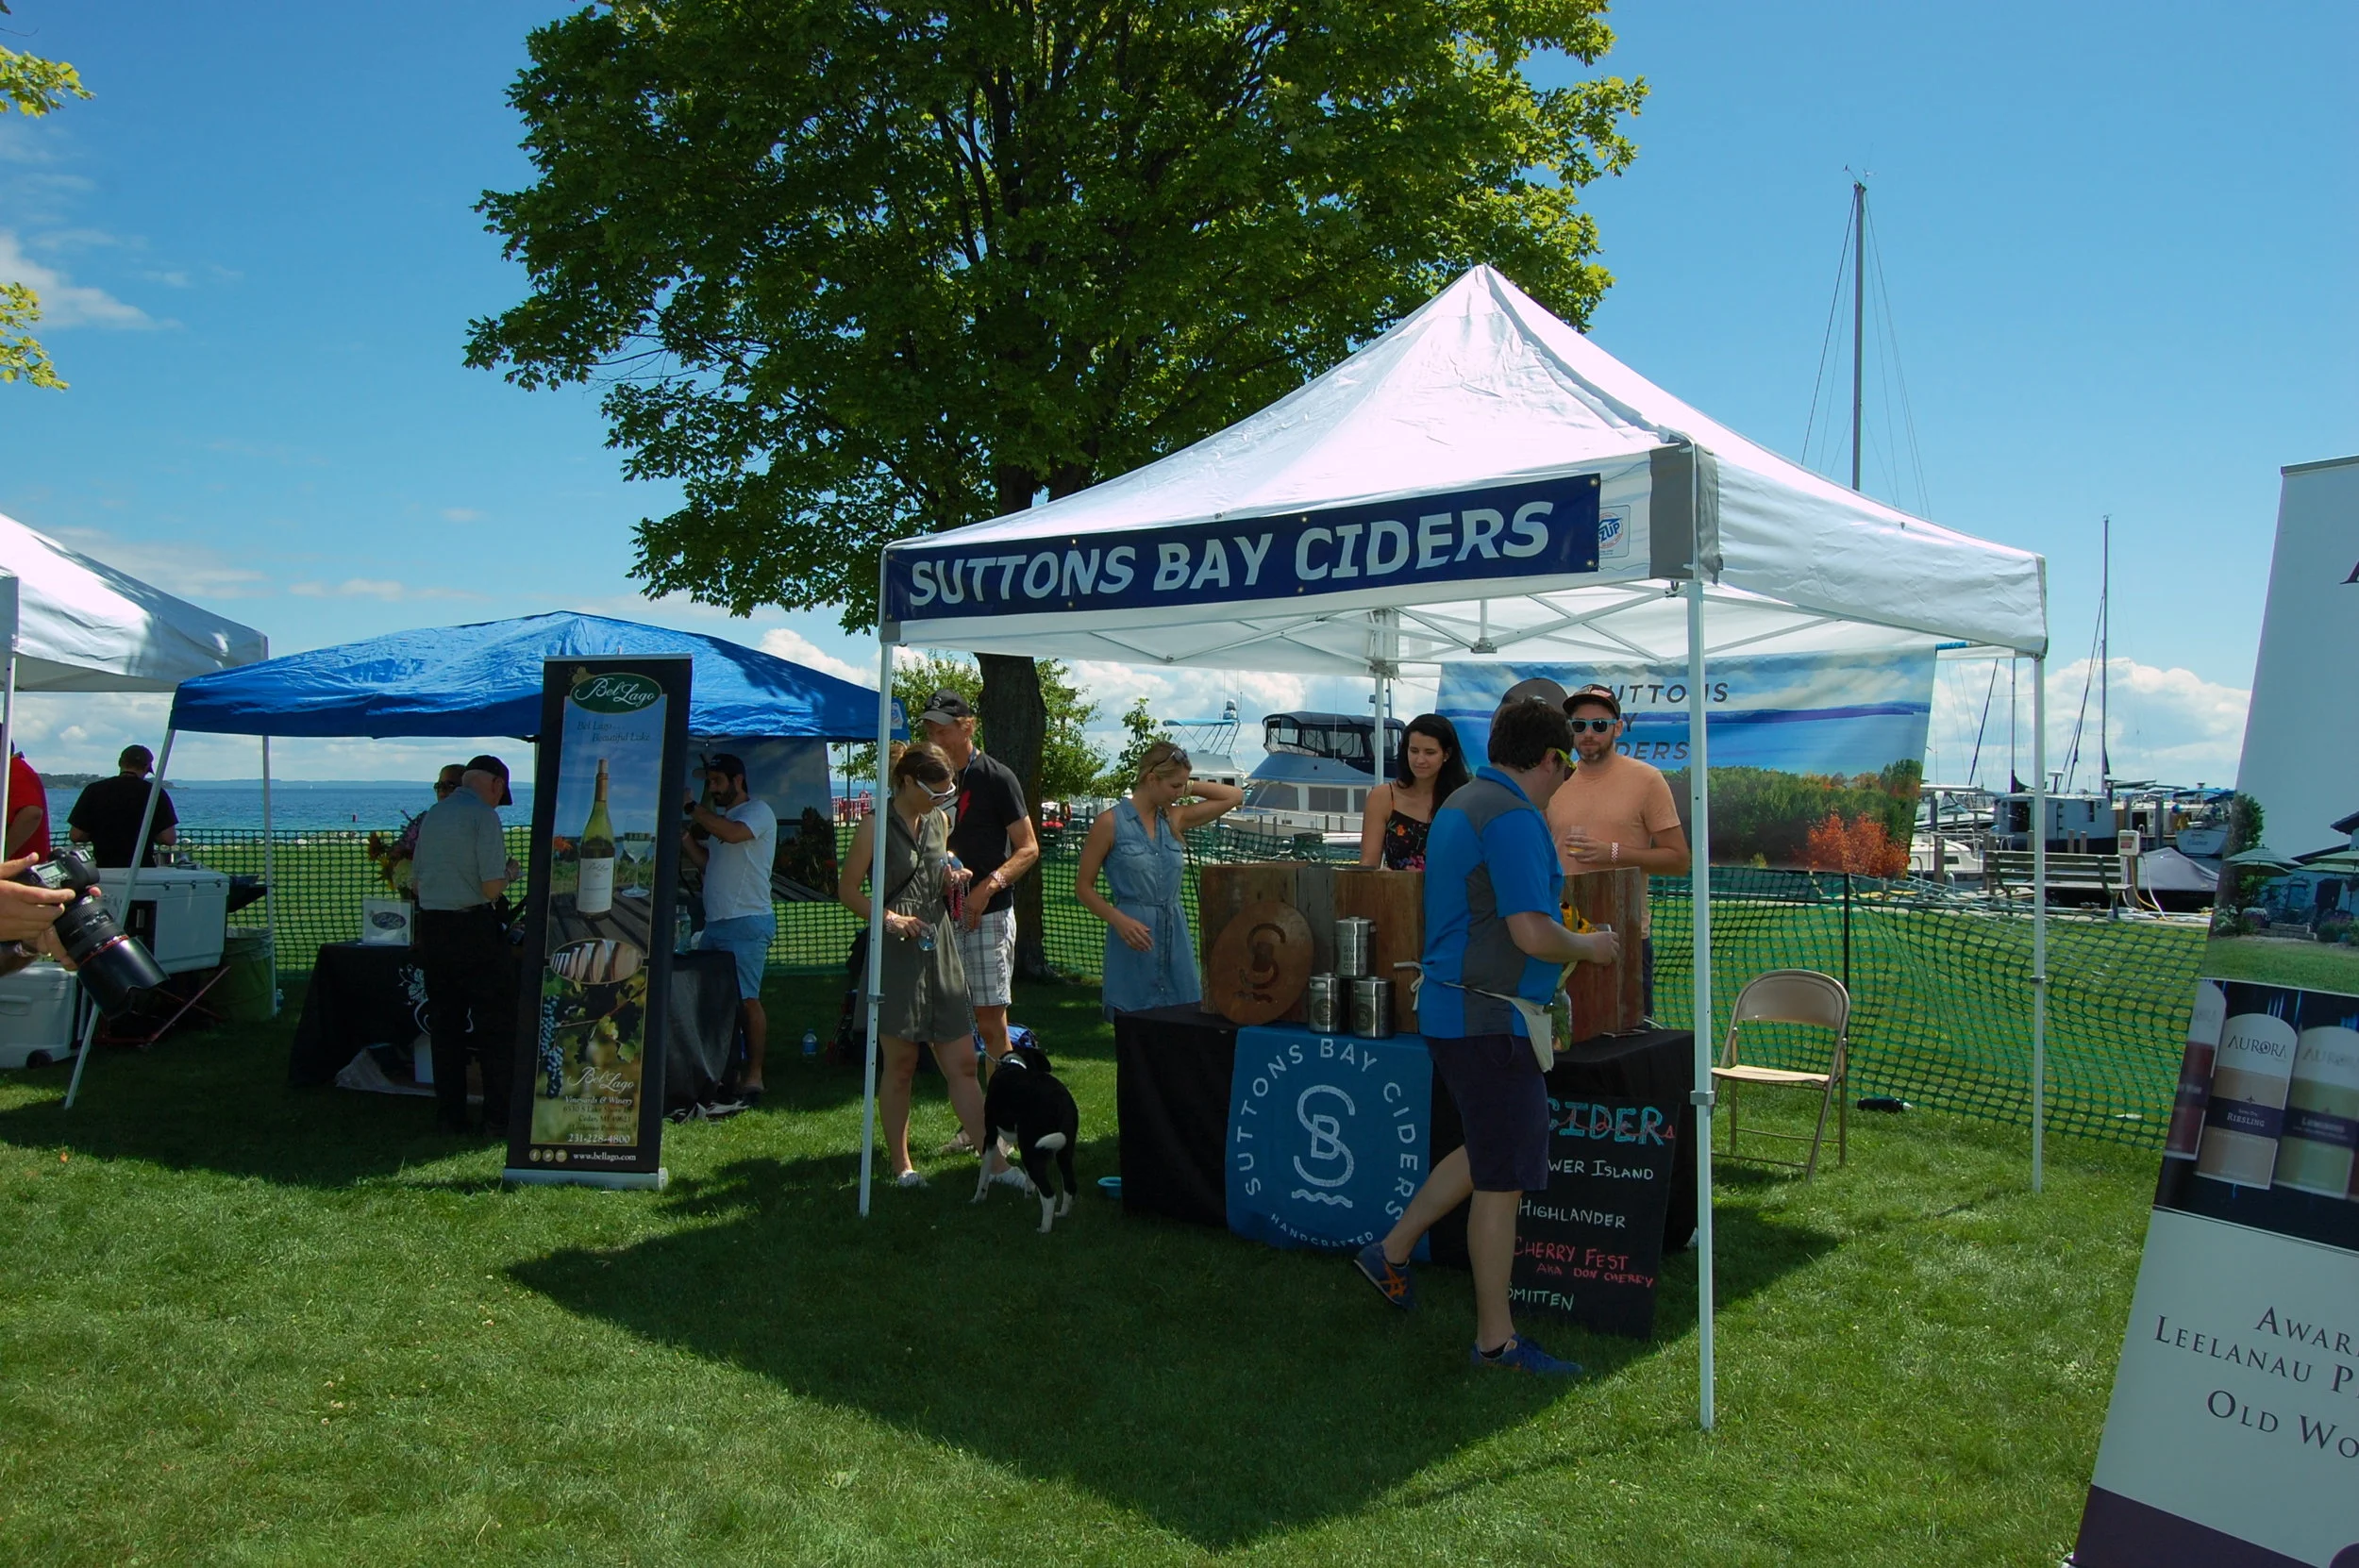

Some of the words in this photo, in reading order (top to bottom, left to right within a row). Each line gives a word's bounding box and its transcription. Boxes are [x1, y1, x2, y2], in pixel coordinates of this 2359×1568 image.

[910, 545, 1136, 607] SUTTONS
[1153, 533, 1274, 592] BAY
[1295, 501, 1554, 581] CIDERS
[575, 677, 625, 701] Bel
[612, 683, 655, 708] Lago
[1609, 682, 1729, 704] UTTOS
[1614, 742, 1691, 760] DERS
[2227, 1034, 2287, 1059] AURORA
[567, 1066, 609, 1086] Bel
[599, 1073, 634, 1093] Lago
[608, 1096, 633, 1107] Winery
[1236, 1043, 1304, 1196] SUTTONS
[1319, 1038, 1378, 1073] BAY
[1382, 1081, 1419, 1221] CIDERS
[2227, 1112, 2266, 1128] RIESLING
[567, 1133, 631, 1143] 231-228-4800
[573, 1151, 637, 1162] www.bellago.com
[1548, 1159, 1585, 1175] WER
[1591, 1159, 1654, 1180] ISLAND
[1517, 1198, 1626, 1228] HIGHLANDER
[1513, 1236, 1576, 1262] CHERRY
[1585, 1247, 1630, 1271] FEST
[1535, 1262, 1563, 1276] AKA
[2254, 1306, 2359, 1357] AWAR
[2153, 1314, 2314, 1383] LEELANAU
[2330, 1363, 2359, 1399] P
[2206, 1390, 2280, 1433] OLD
